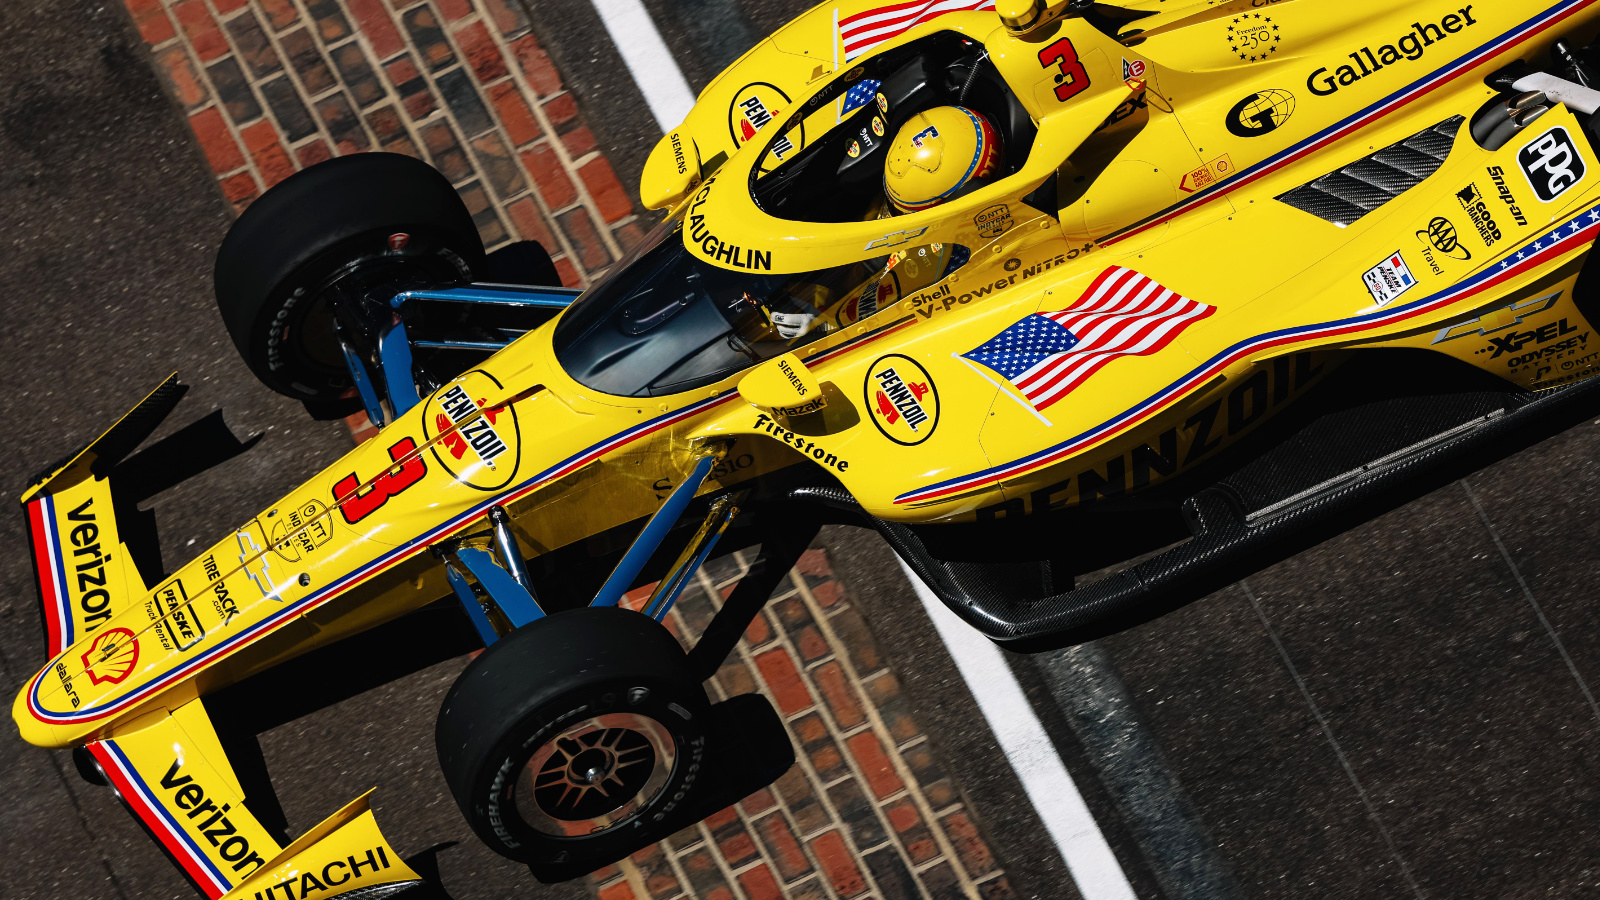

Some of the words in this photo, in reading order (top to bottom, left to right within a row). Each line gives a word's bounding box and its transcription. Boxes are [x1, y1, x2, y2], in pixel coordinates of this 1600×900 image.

[1236, 25, 1268, 36] Freedom
[1240, 30, 1270, 50] 250
[1306, 4, 1477, 97] Gallagher
[1037, 36, 1091, 102] 3
[670, 132, 688, 175] SIEMENS
[987, 207, 1004, 219] NTT
[1486, 165, 1528, 227] Snap-on
[977, 213, 1011, 231] INDYCAR
[1429, 219, 1458, 252] AAA
[1467, 206, 1495, 247] RANCHERS
[1475, 201, 1502, 241] GOOD
[1377, 266, 1397, 293] PENSKE
[1386, 267, 1402, 288] TEAM
[1421, 245, 1444, 276] Travel
[911, 284, 951, 308] Shell
[916, 272, 1018, 319] V-Power
[267, 286, 305, 371] Firestone
[1488, 317, 1578, 360] XPEL
[1507, 331, 1590, 368] ODYSSEY
[1510, 343, 1588, 374] BATTERY
[1575, 351, 1599, 366] NTT
[777, 359, 808, 396] SIEMENS
[771, 397, 826, 417] Mazak
[874, 367, 929, 431] PENNZOIL
[753, 413, 849, 473] Firestone
[331, 435, 428, 525] 3
[288, 511, 315, 553] INDCAR
[143, 600, 159, 621] Truck
[212, 599, 226, 620] .com
[56, 662, 80, 709] dallara
[653, 735, 706, 822] Firestone
[160, 757, 266, 880] verizon
[488, 755, 522, 850] FIREHAWK
[240, 846, 391, 900] ITACHI
